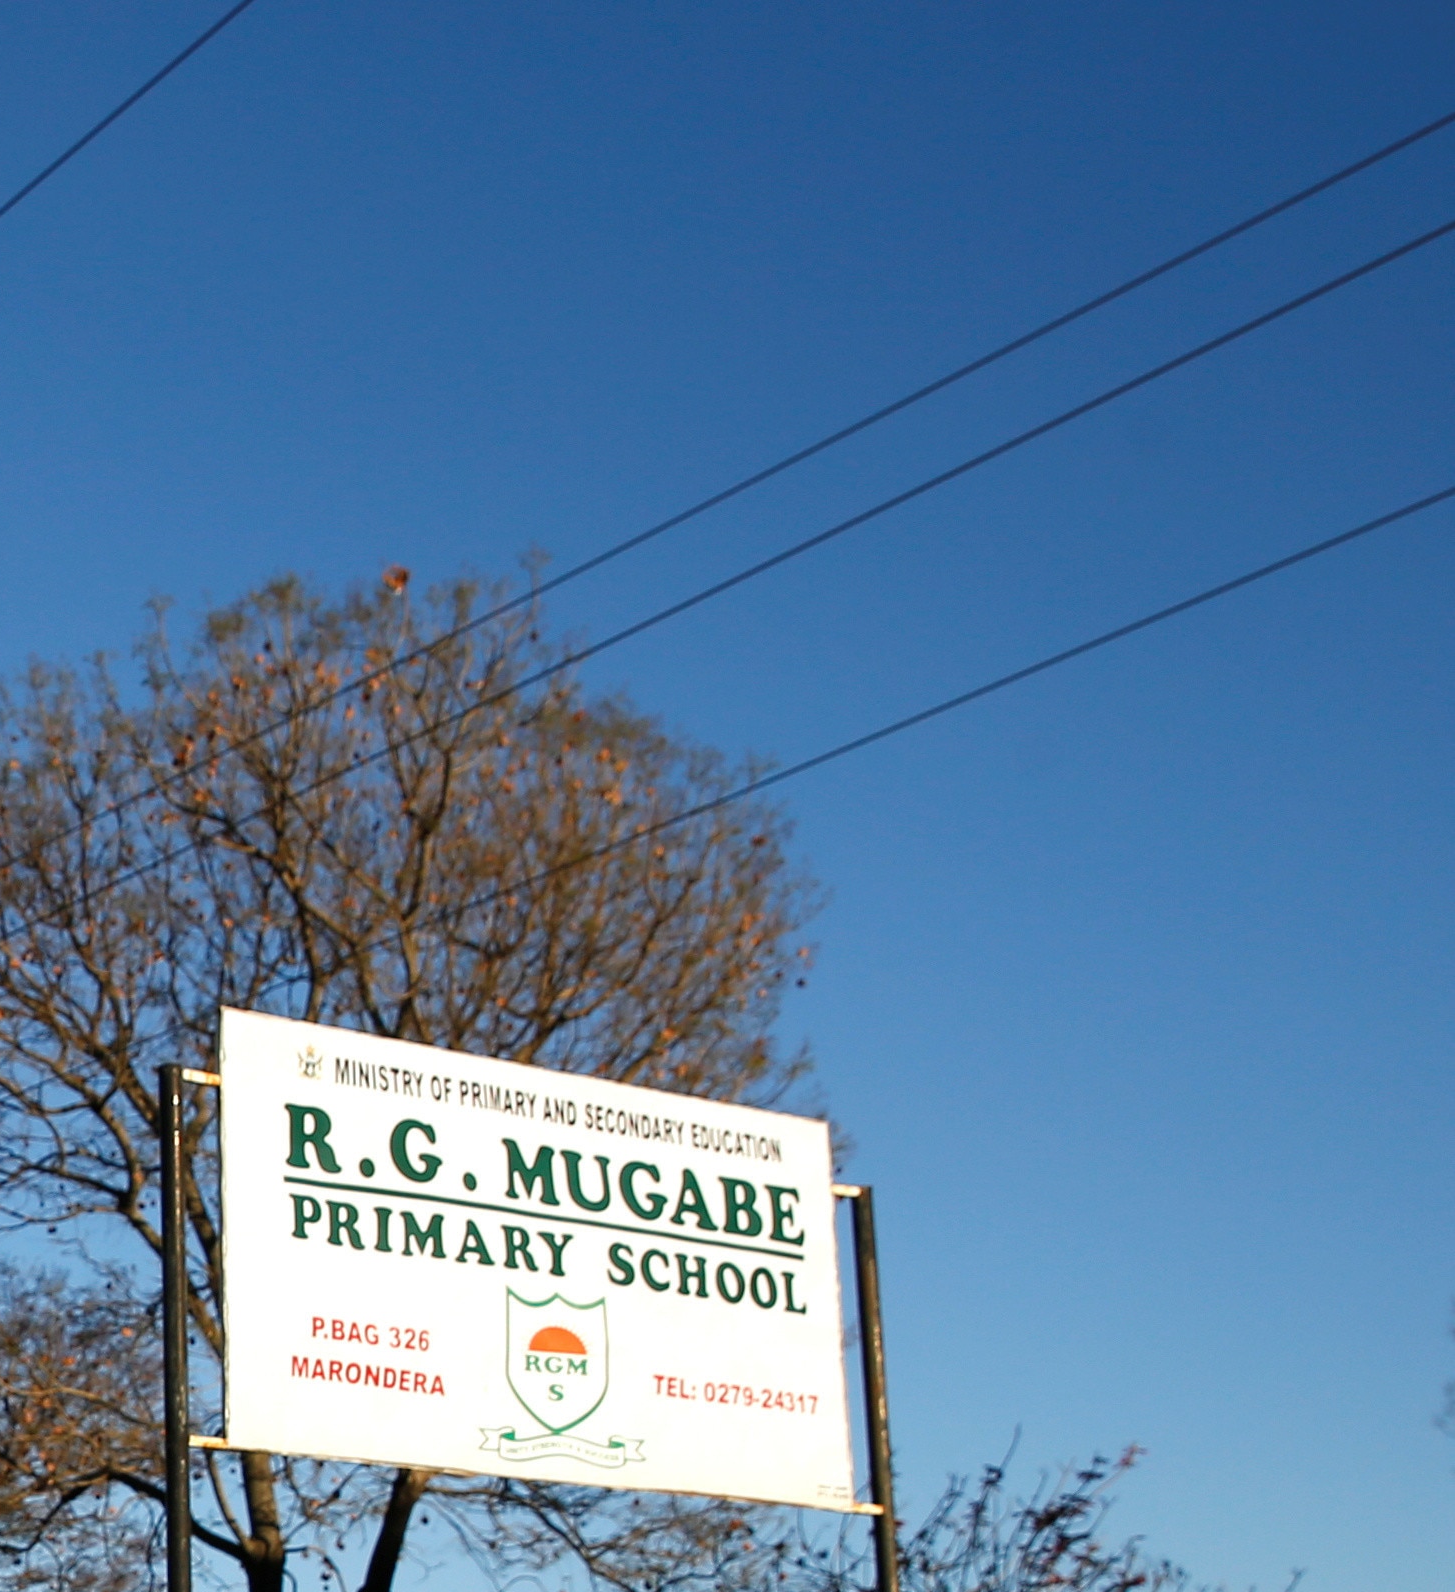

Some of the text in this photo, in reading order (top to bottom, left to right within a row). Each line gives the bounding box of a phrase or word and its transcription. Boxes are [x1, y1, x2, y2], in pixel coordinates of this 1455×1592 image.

[335, 1057, 783, 1162] MINISTRY OF PRIMARY AND SECONDARY EDUCATION
[501, 1137, 805, 1247] MUGABE
[289, 1193, 807, 1315] PRIMARY SCHOOL
[311, 1316, 430, 1352] P.BAG 326
[291, 1355, 445, 1396] MARONDERA
[525, 1354, 588, 1376] RGM
[548, 1384, 564, 1401] S
[652, 1374, 819, 1415] TEL: 0279-24317
